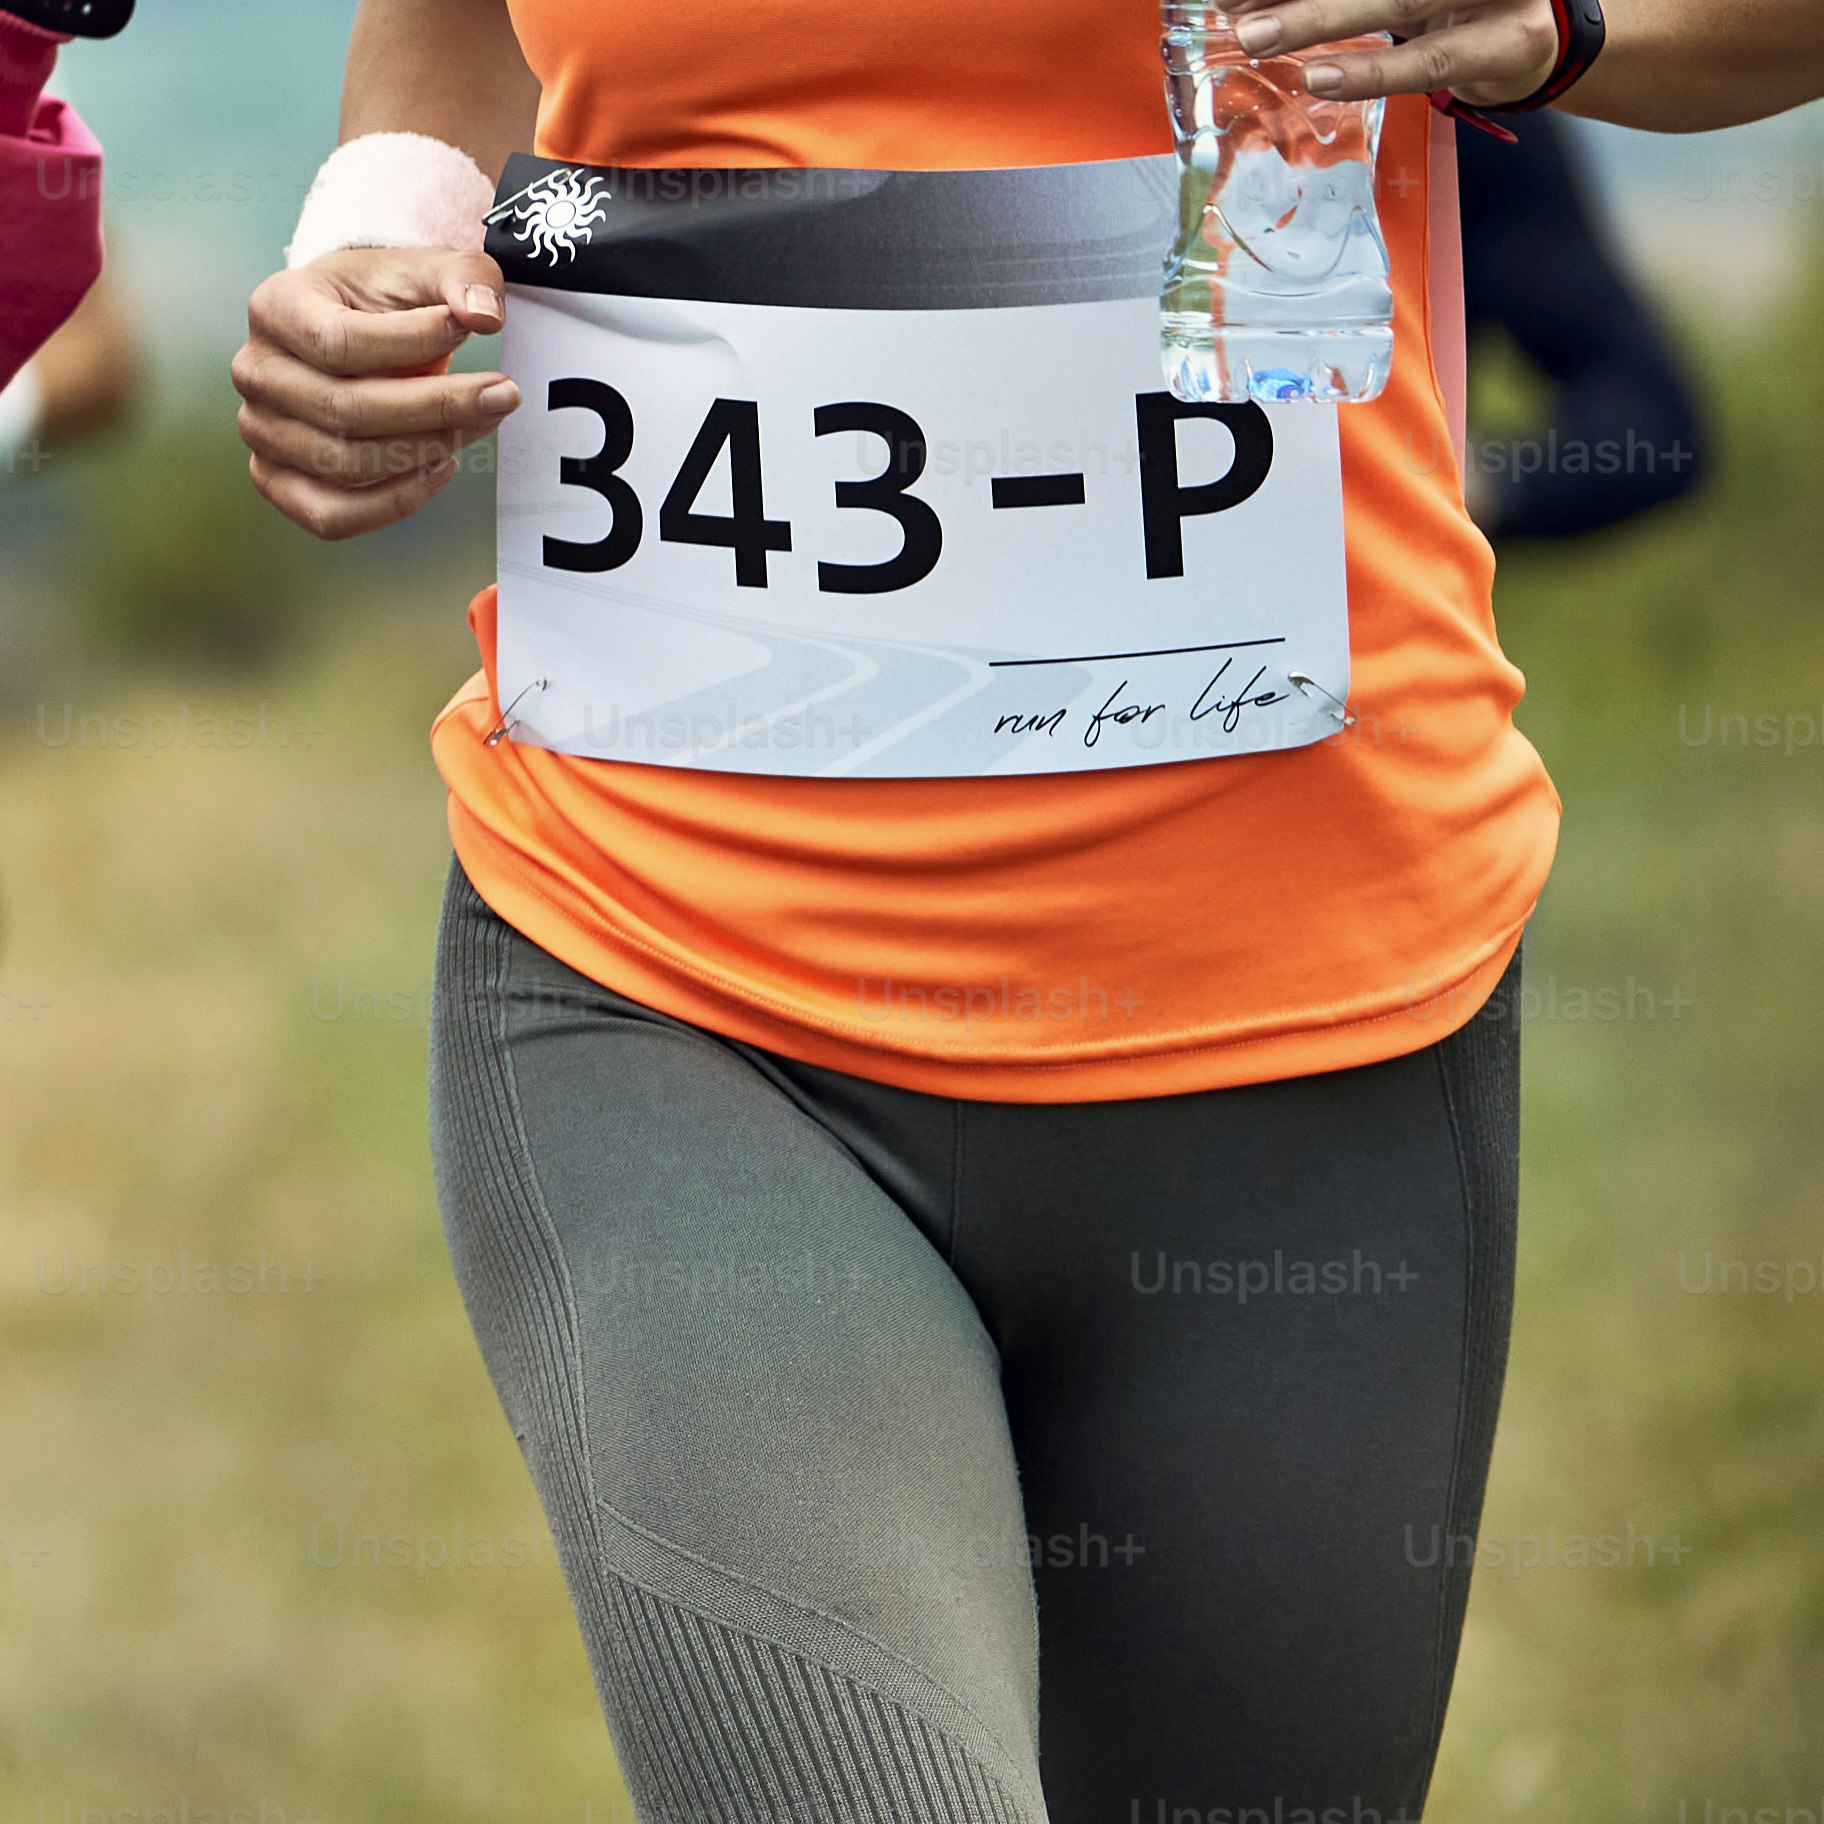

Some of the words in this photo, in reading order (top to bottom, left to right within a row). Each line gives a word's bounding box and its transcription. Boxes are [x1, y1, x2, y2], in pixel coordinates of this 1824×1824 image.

[542, 377, 1275, 595] 343-P
[993, 708, 1067, 737] run
[1084, 680, 1166, 748] for
[1190, 657, 1290, 734] life
